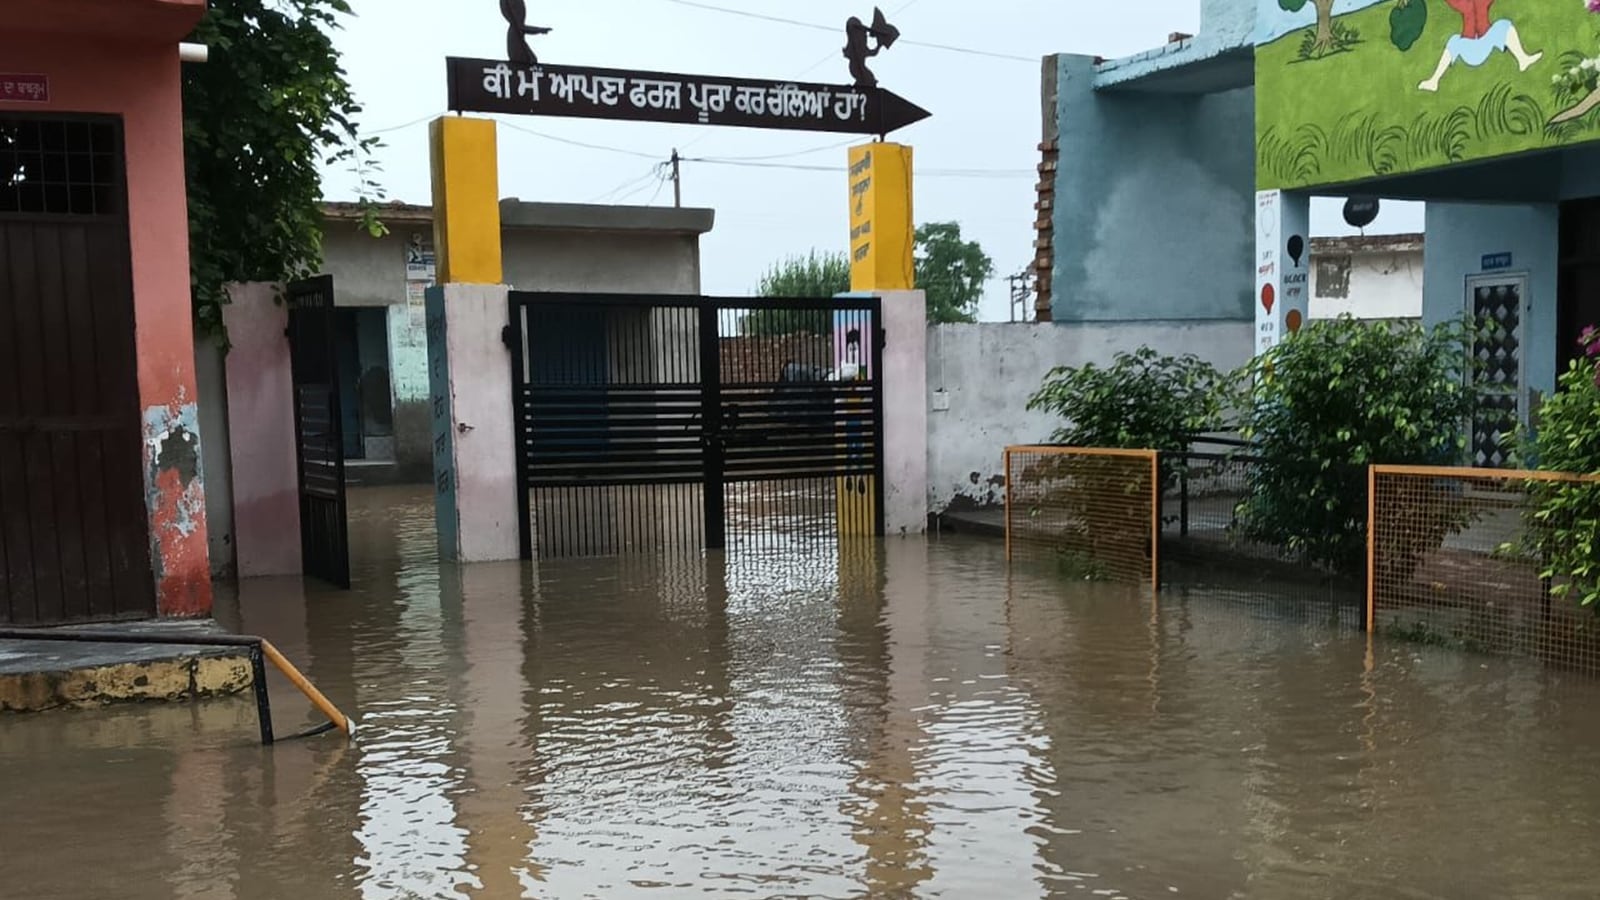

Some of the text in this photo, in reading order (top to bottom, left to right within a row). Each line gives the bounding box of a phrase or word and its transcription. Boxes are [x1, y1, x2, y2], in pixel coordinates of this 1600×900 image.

[482, 63, 513, 99] ਕੀ
[548, 72, 627, 106] ਆਪਣਾ
[629, 78, 682, 110] ਫਰਜ਼
[687, 82, 732, 123] ਪੂਰਾ
